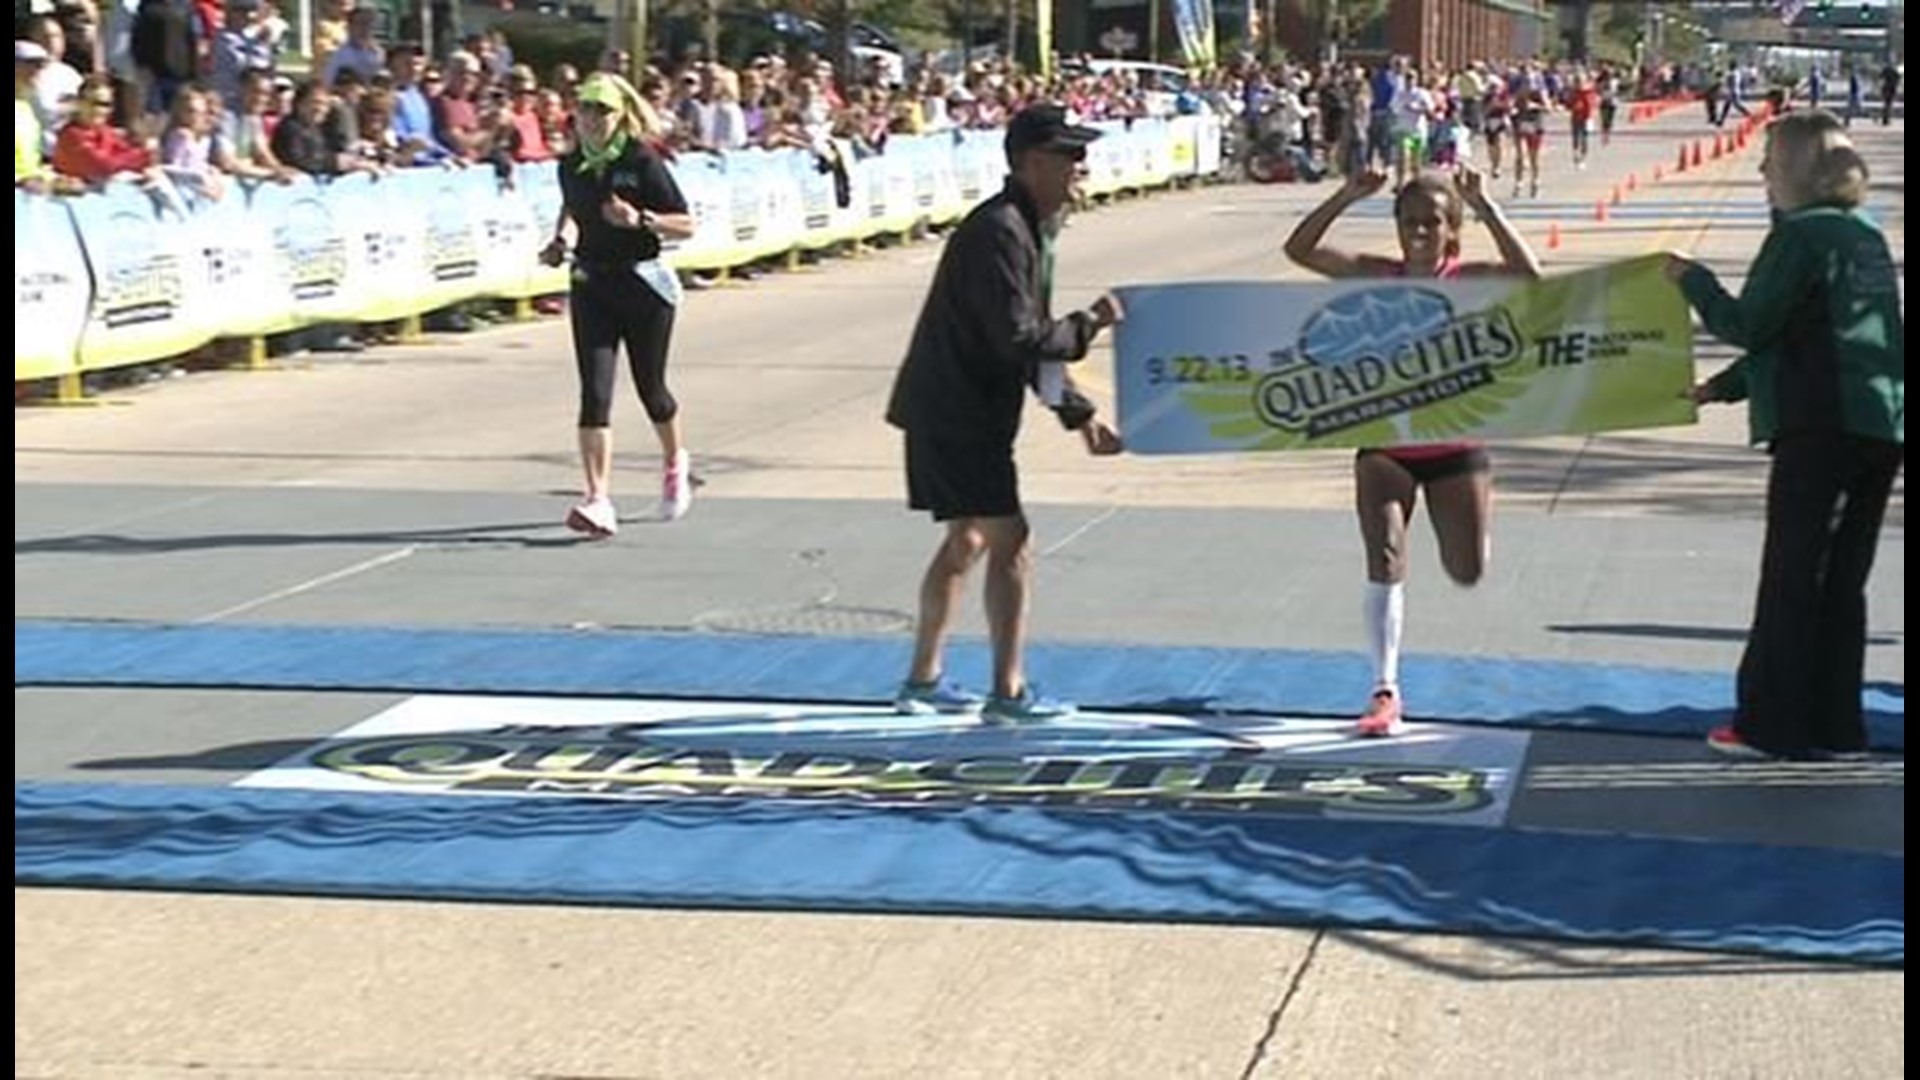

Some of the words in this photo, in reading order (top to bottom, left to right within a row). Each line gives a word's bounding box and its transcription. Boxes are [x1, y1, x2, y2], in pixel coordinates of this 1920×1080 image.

[1263, 354, 1386, 423] QUAD
[1391, 318, 1515, 382] CITIES
[1534, 330, 1586, 367] THE
[1313, 368, 1488, 432] MARATHON
[330, 737, 894, 784] QUAD
[912, 755, 1478, 808] CITIES
